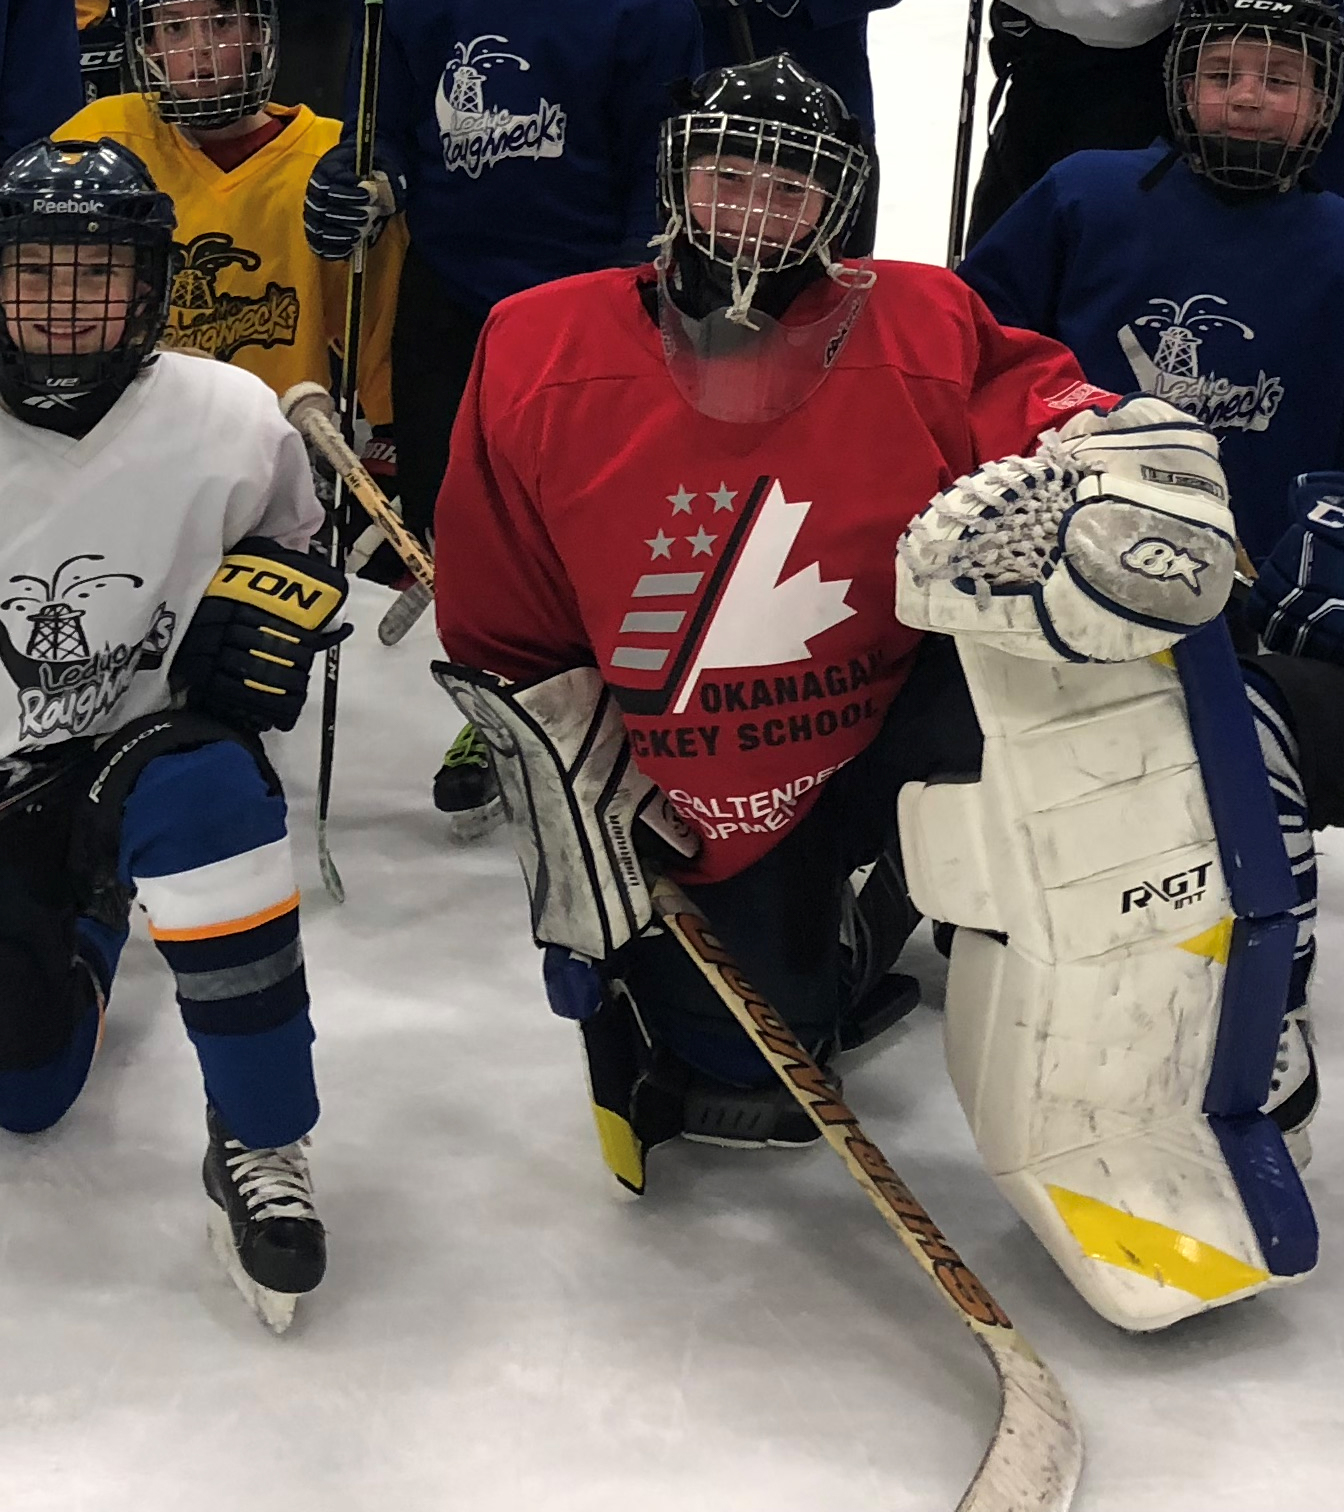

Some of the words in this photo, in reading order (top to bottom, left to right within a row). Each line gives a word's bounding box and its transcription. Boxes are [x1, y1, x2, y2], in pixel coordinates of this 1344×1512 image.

[80, 48, 124, 68] CC
[33, 197, 105, 216] Reebok
[634, 724, 724, 760] CKEY
[737, 698, 880, 753] SCHOOL
